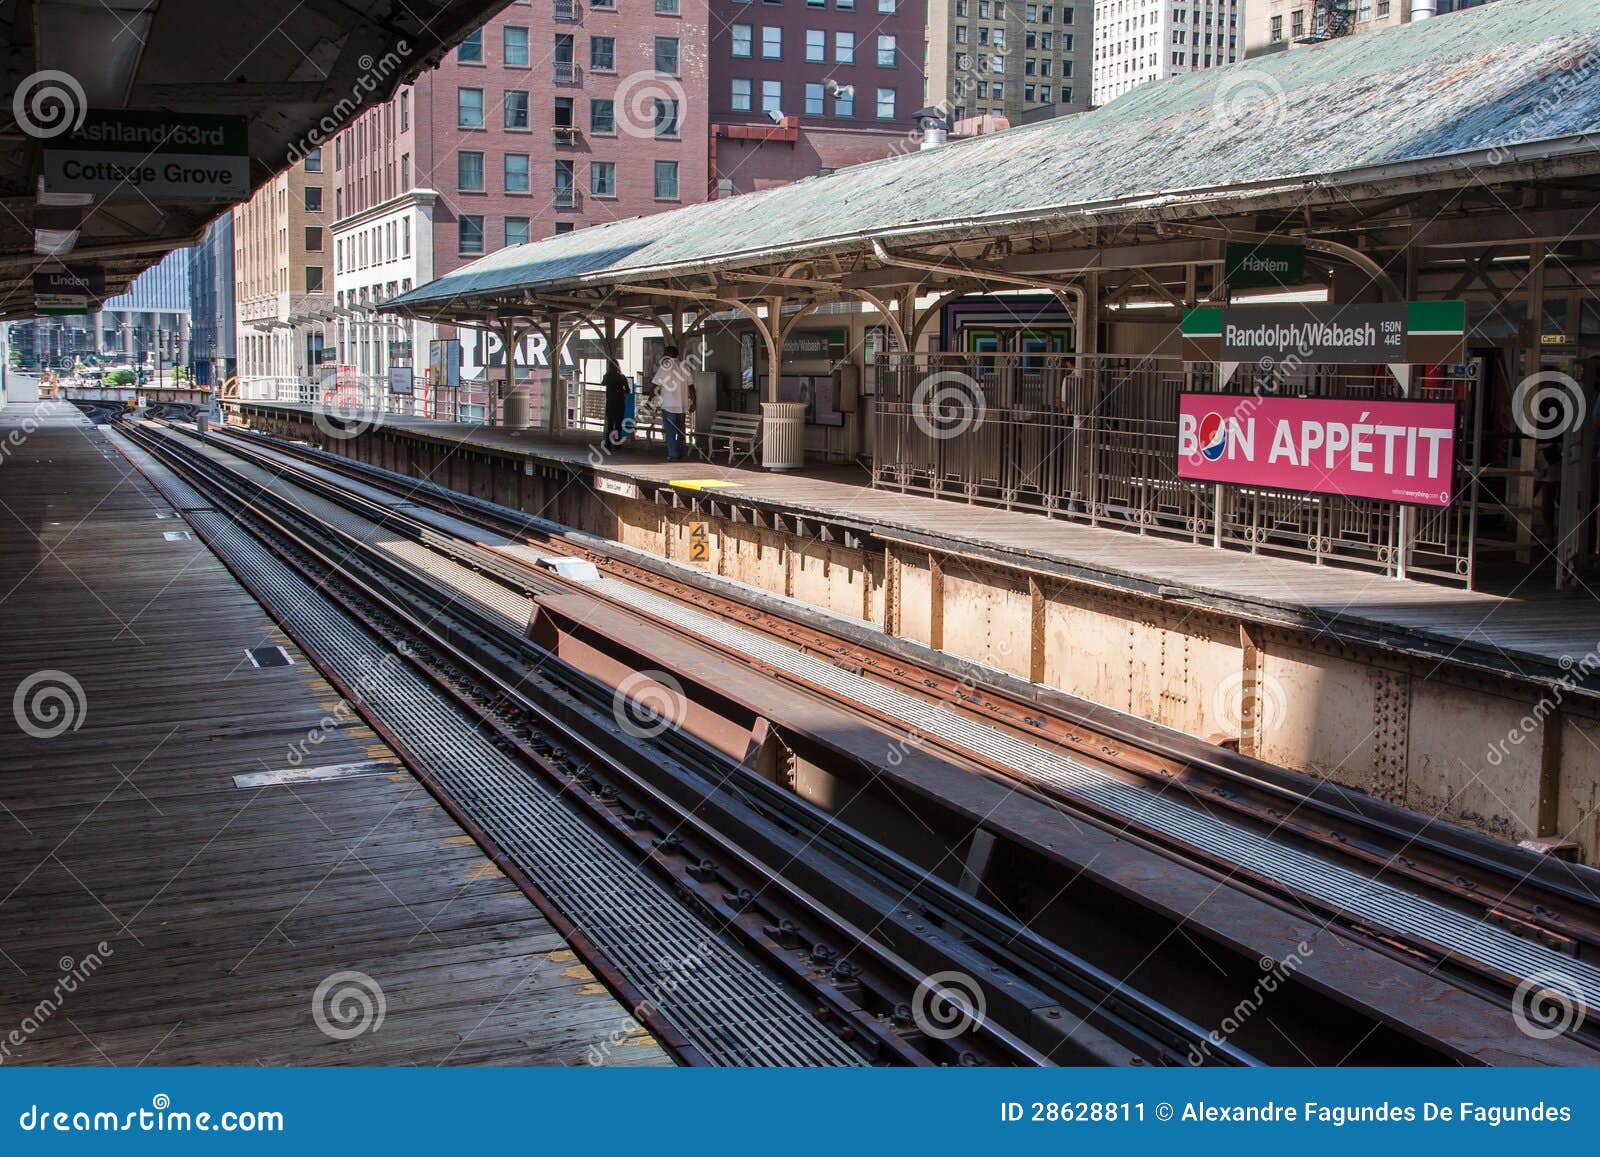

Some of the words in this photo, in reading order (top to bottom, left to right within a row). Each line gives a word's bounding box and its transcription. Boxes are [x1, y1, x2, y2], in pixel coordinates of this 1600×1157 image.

[70, 121, 225, 146] Ashland/63rd
[63, 160, 156, 187] Cottage
[163, 163, 233, 184] Grove
[1243, 257, 1289, 273] Harlem
[50, 274, 89, 287] Linden
[1380, 320, 1402, 333] 150N
[1225, 322, 1376, 352] Randolph/Wabash
[1384, 333, 1401, 346] 44E
[1268, 411, 1453, 479] APPÉTIT
